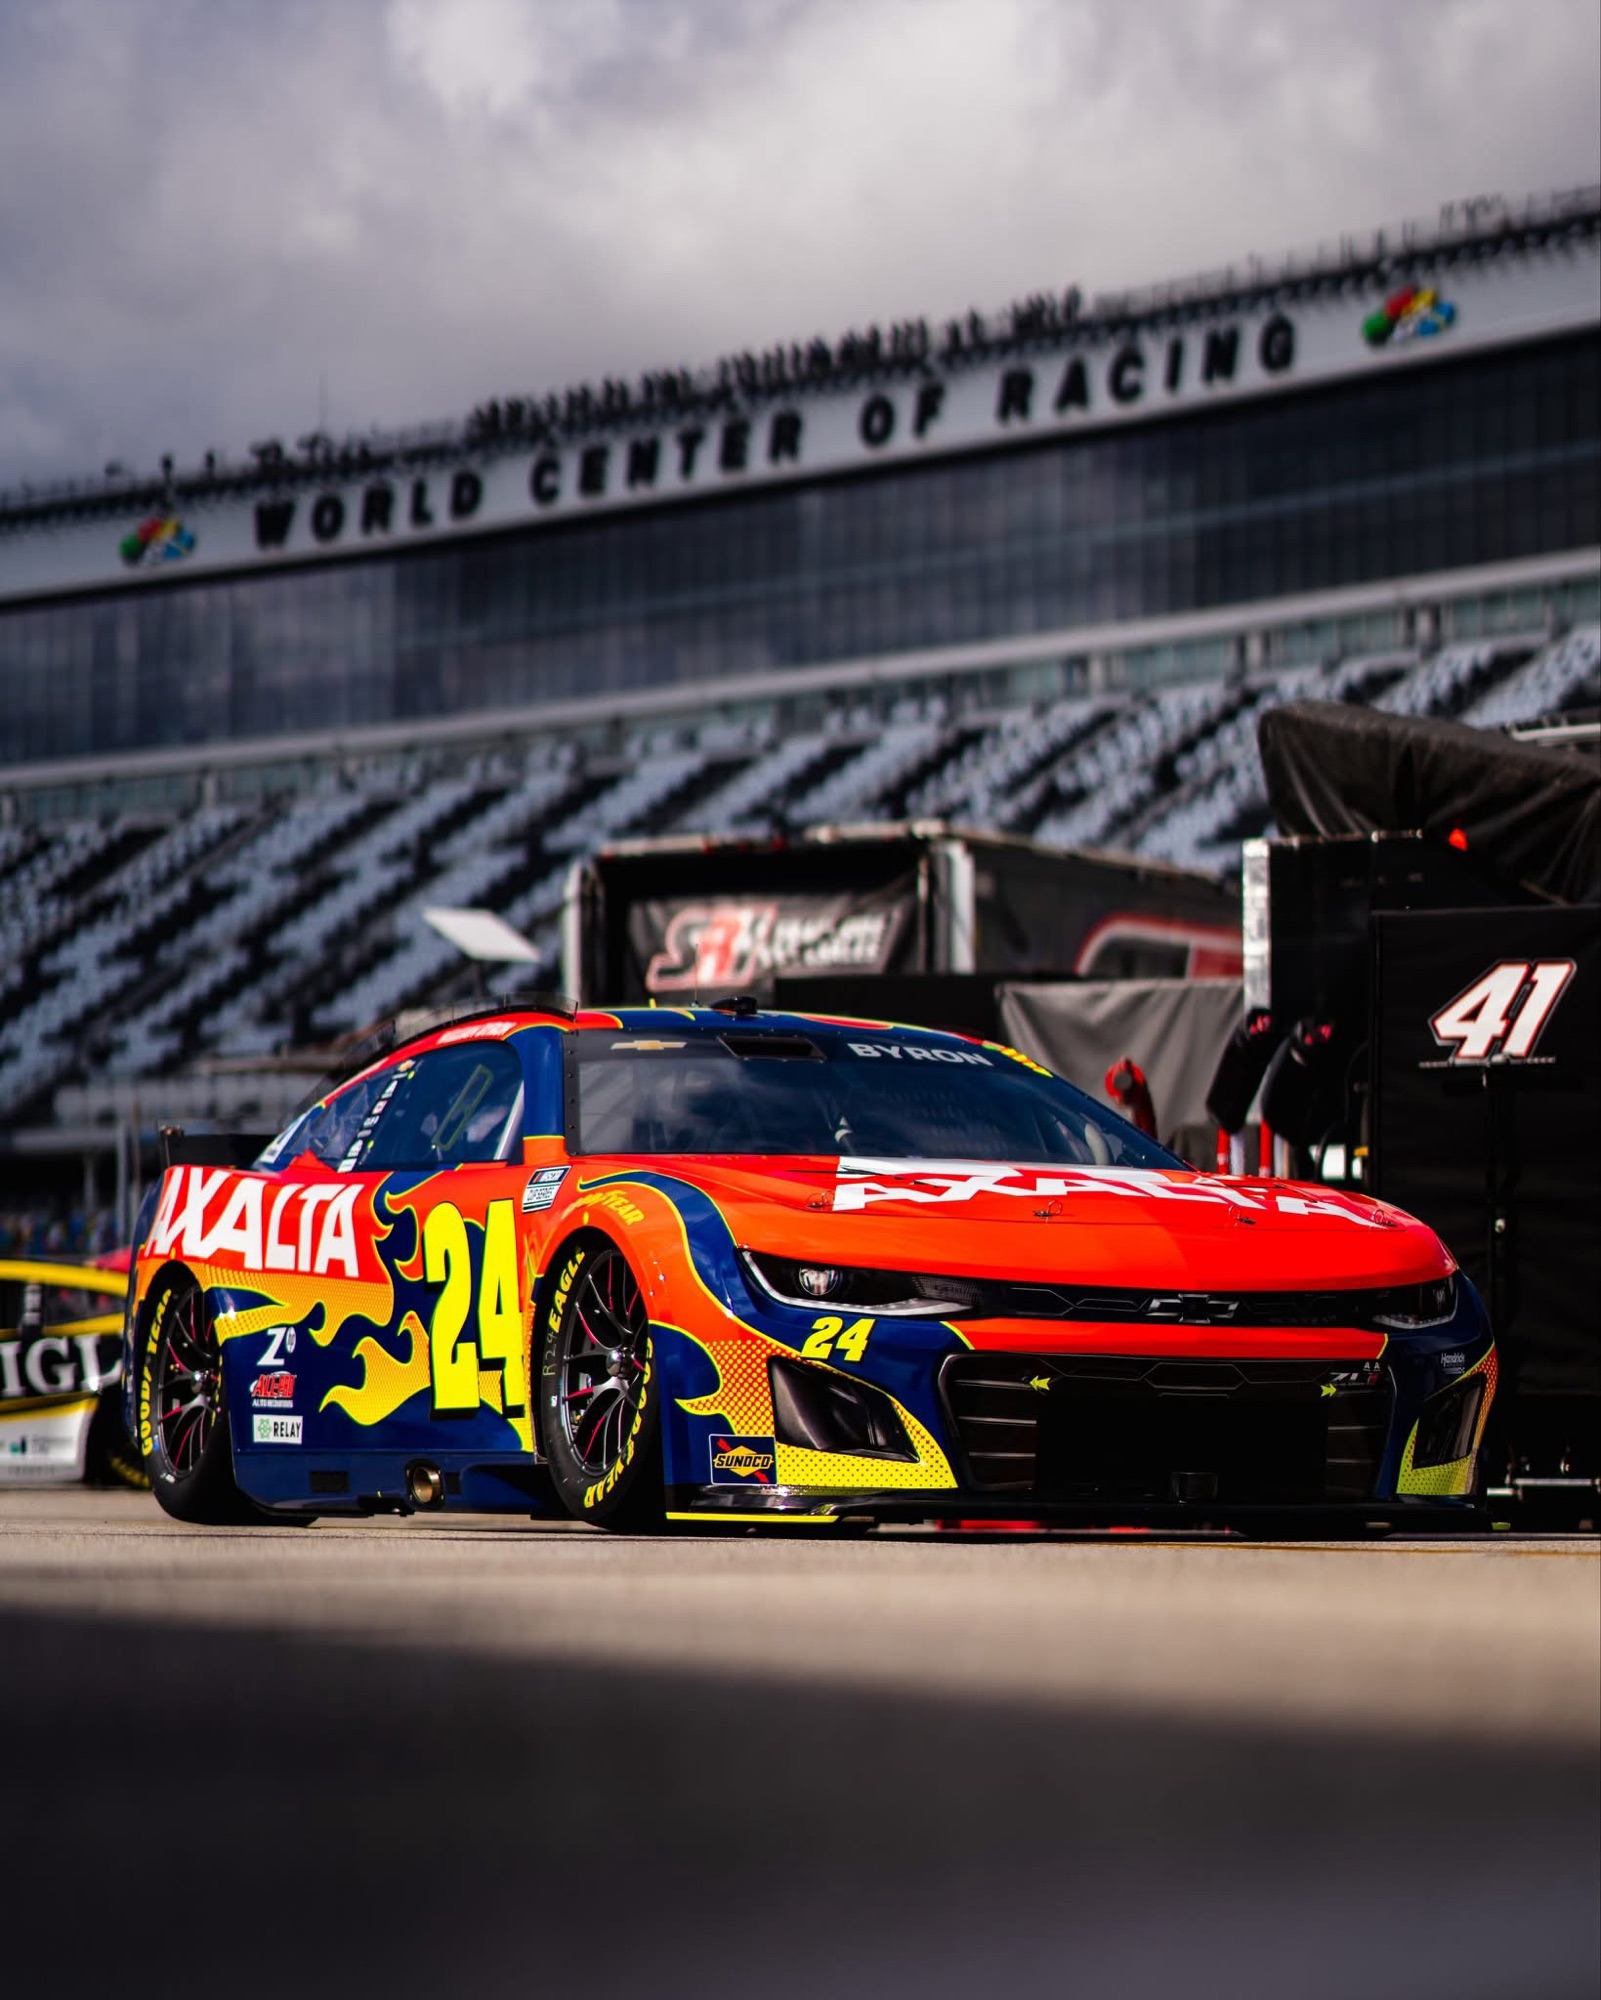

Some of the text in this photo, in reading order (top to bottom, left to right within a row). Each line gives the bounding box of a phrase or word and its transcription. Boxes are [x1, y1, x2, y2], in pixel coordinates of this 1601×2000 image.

[255, 313, 1296, 550] WORLD CENTER OF RACING
[1429, 959, 1575, 1062] 41
[848, 1043, 993, 1066] BYRON
[145, 1166, 365, 1278] AXALTA
[422, 1198, 525, 1415] 24
[800, 1316, 876, 1361] 24
[273, 1421, 302, 1438] RELAY
[715, 1454, 771, 1468] SUNOCO
